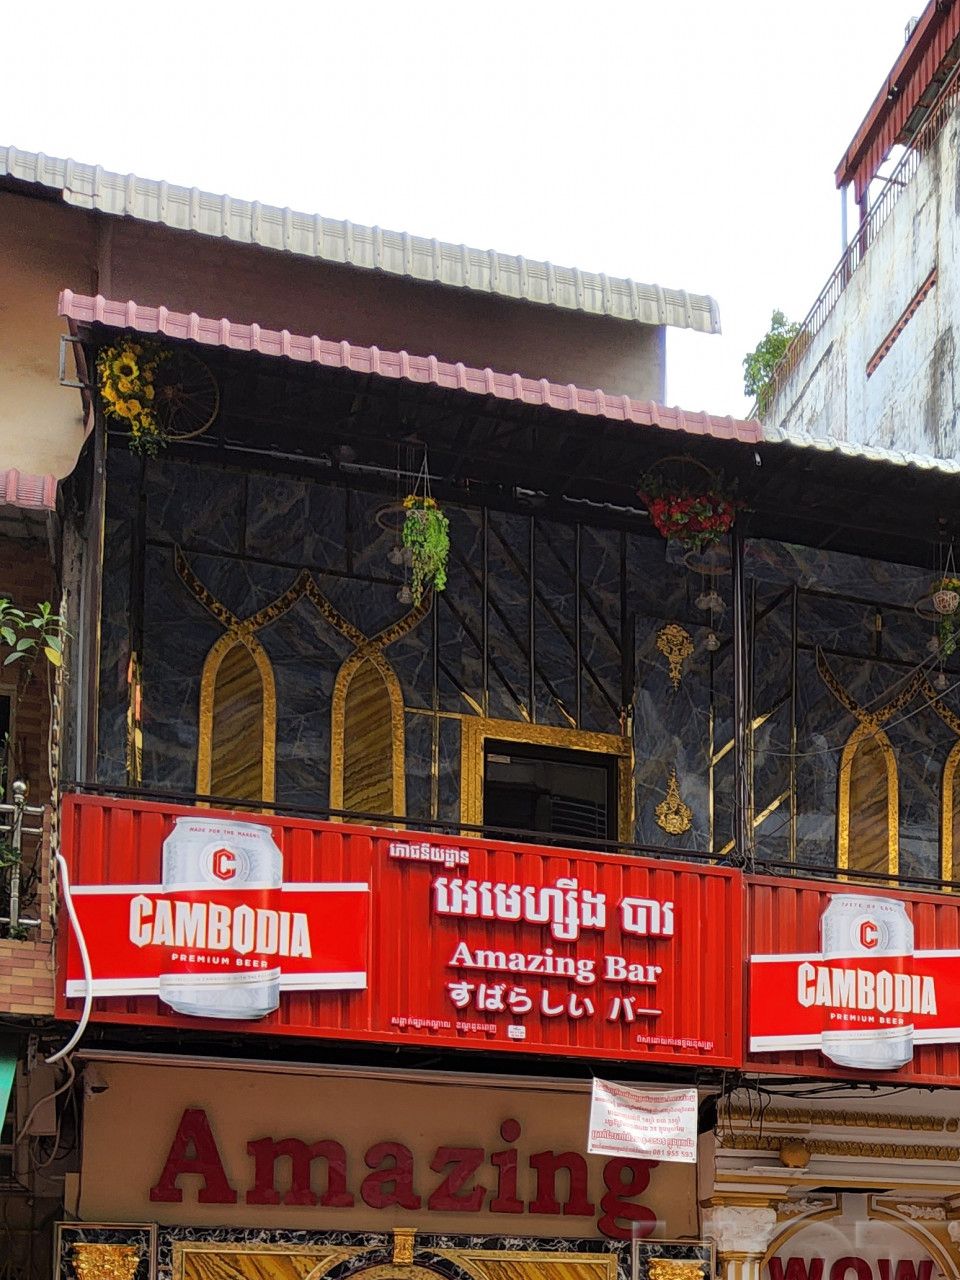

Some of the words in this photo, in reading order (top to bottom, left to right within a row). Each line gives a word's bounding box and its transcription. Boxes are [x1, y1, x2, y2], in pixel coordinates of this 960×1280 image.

[128, 894, 312, 959] CAMBODIA
[171, 952, 230, 966] PREMIUM
[235, 957, 269, 969] BEER
[449, 941, 596, 983] Amazing
[604, 954, 663, 983] Bar
[447, 982, 596, 1017] すばらしい
[607, 995, 663, 1022] バー
[796, 962, 938, 1017] CAMBODIA
[830, 1012, 875, 1023] PREMIUM
[879, 1016, 905, 1026] BEER
[149, 1108, 660, 1240] Amazing
